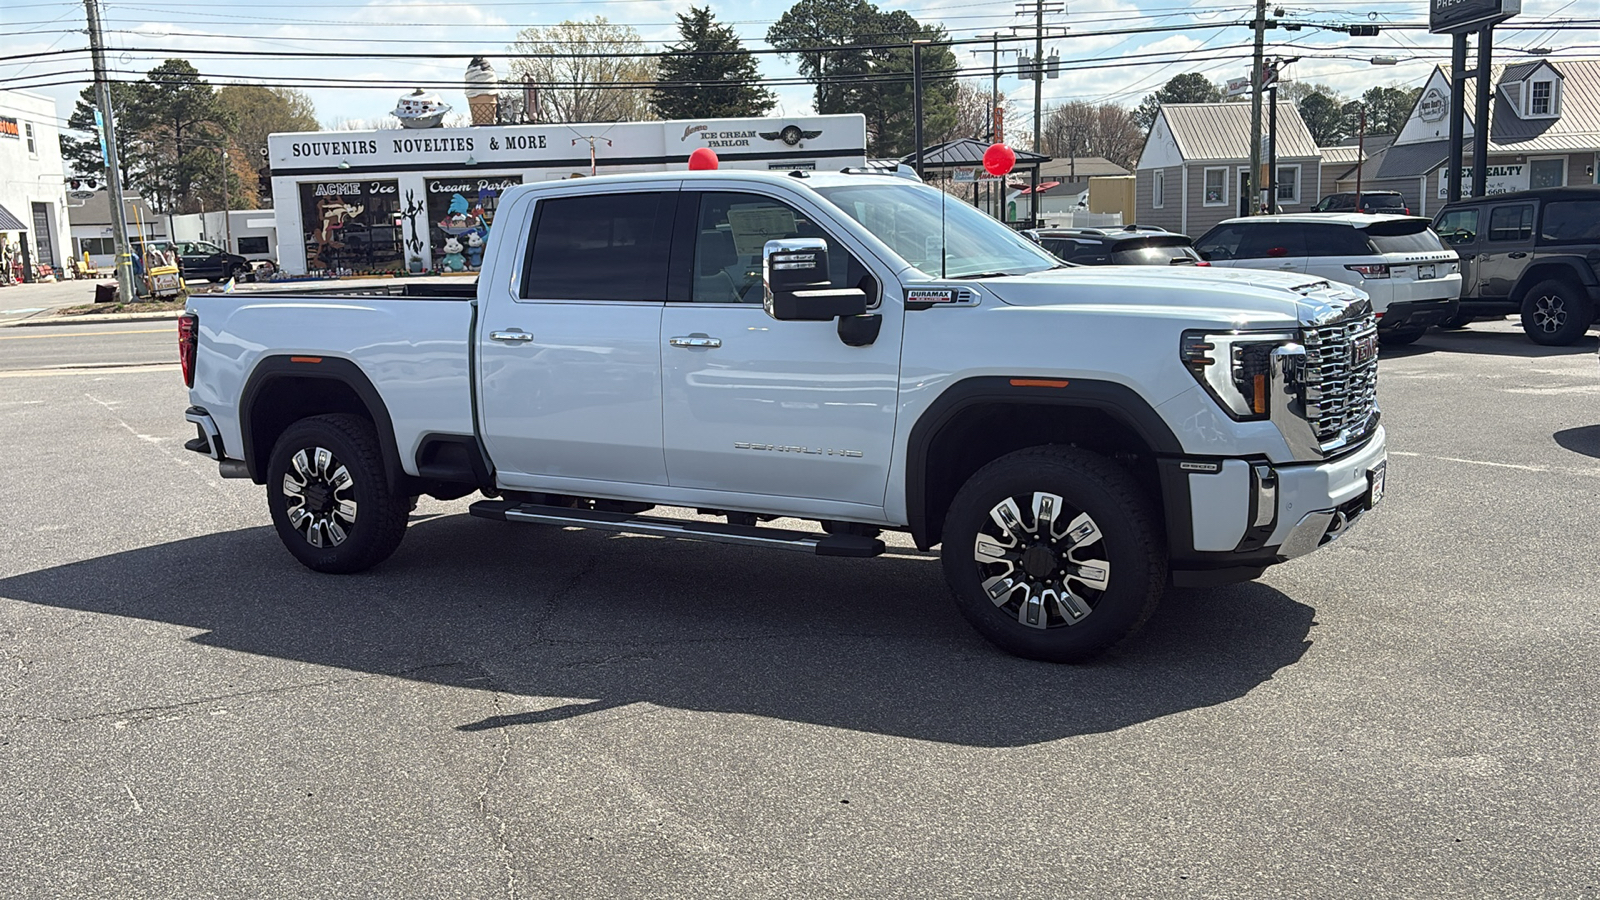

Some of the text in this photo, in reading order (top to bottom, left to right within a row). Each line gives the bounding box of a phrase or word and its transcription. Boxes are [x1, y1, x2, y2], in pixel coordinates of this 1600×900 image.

[701, 131, 757, 140] ICE CREAM
[293, 135, 547, 157] SOUVENIRS NOVELTIES & MORE
[708, 139, 750, 148] PARLOR
[315, 182, 397, 196] ACME Ice
[429, 181, 472, 194] Cream
[734, 441, 864, 458] DENALI HD
